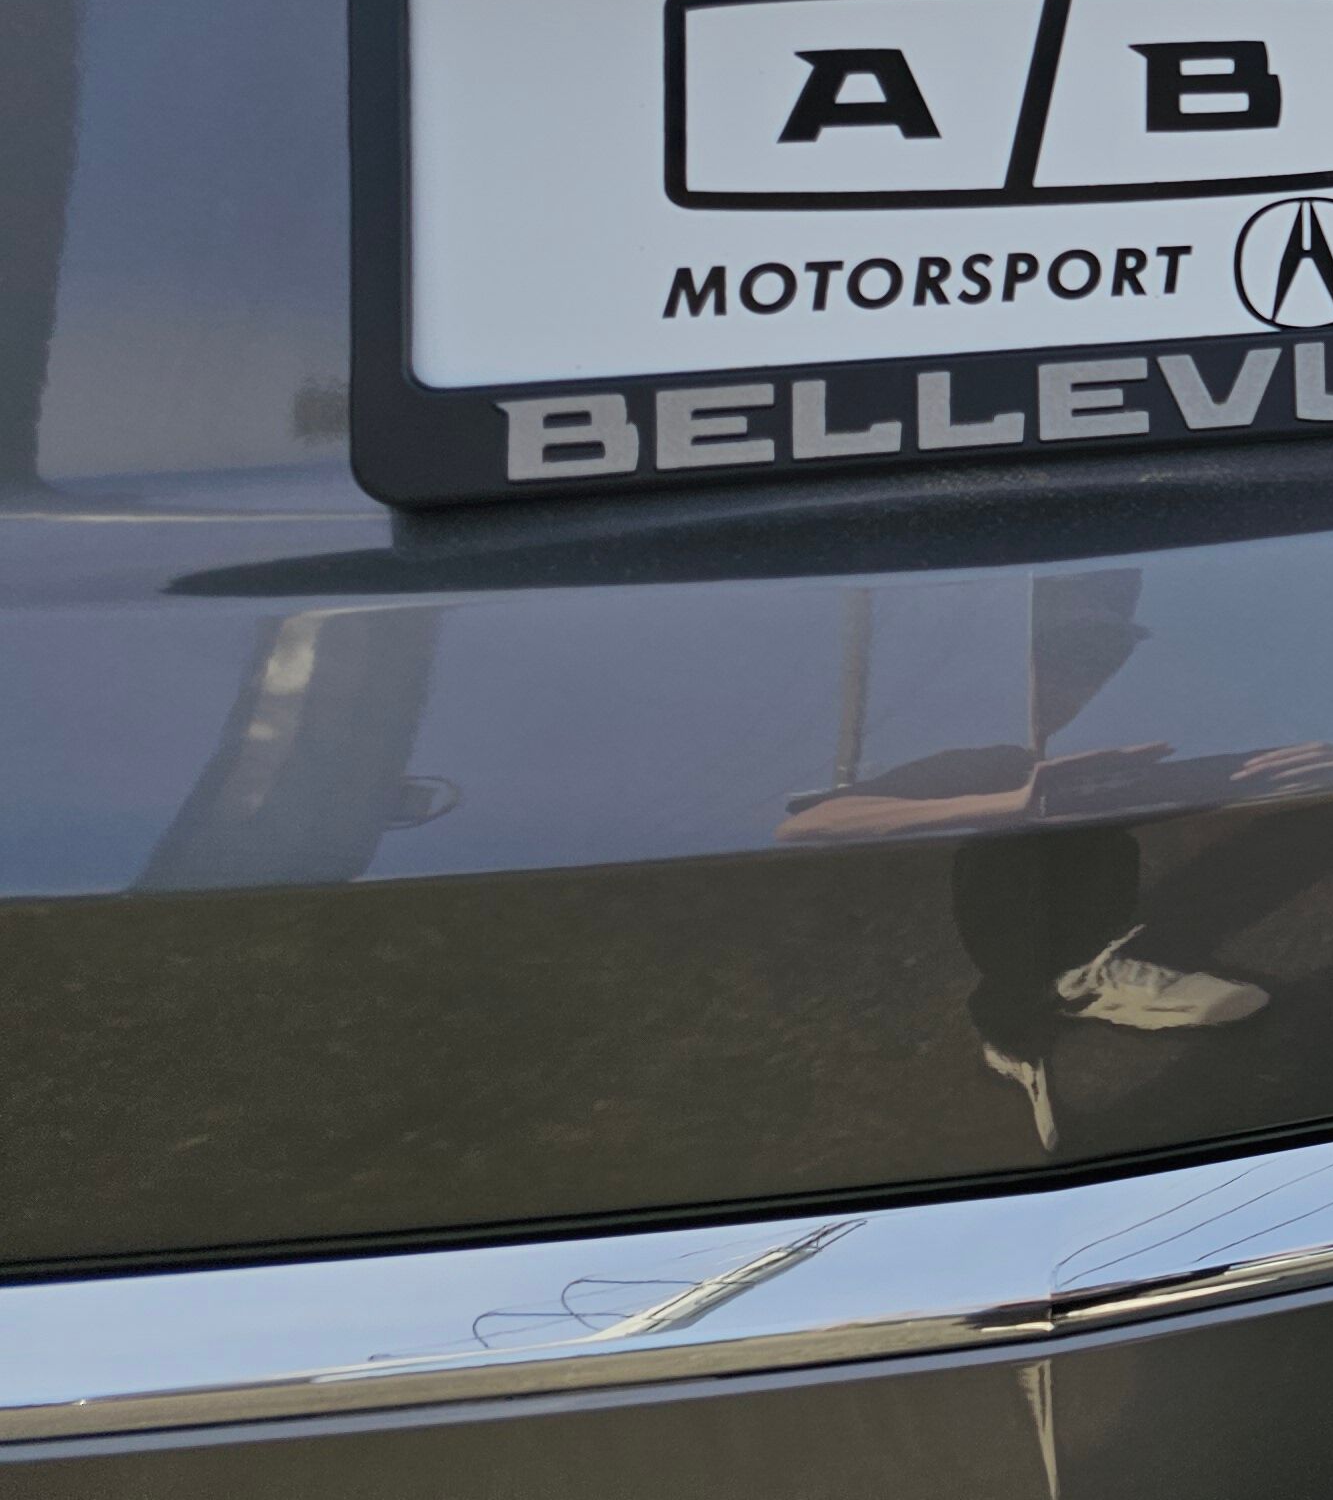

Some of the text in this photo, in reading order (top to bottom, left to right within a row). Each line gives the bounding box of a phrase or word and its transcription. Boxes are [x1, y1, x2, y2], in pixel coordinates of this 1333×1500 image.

[777, 40, 1283, 144] A B
[662, 245, 1195, 320] MOTORSPORT
